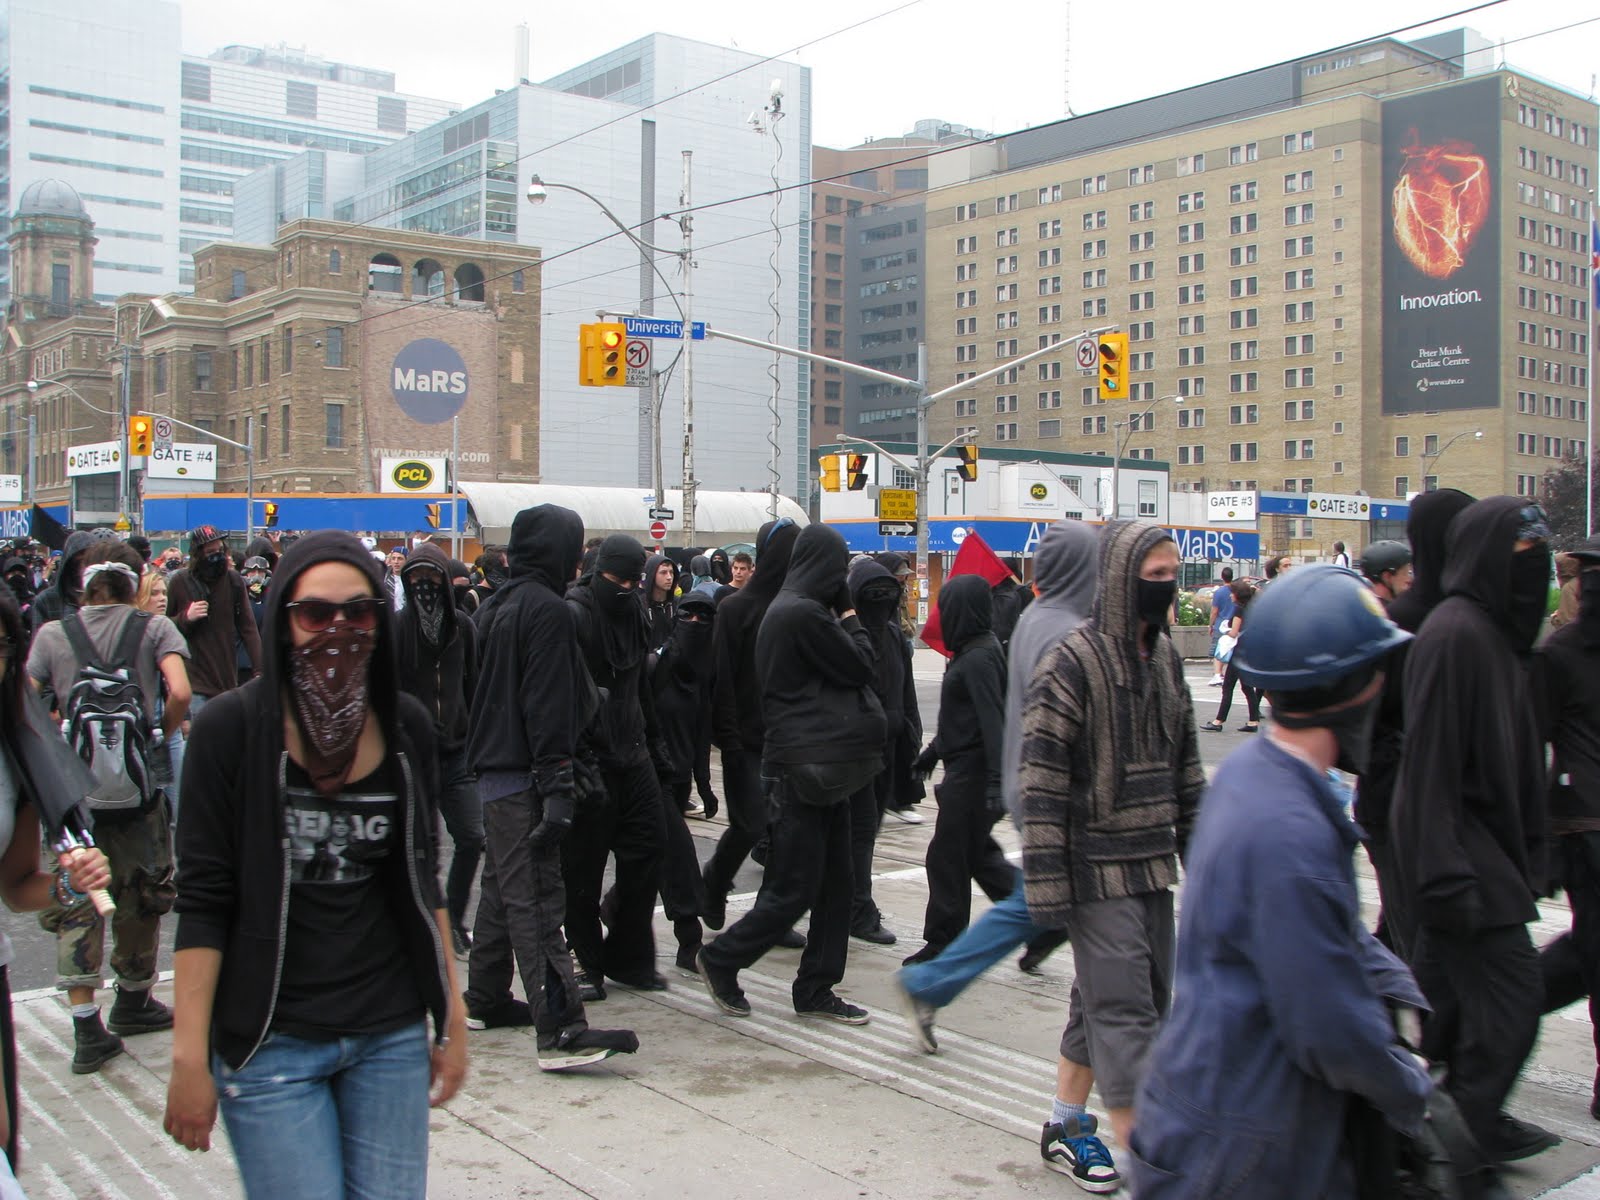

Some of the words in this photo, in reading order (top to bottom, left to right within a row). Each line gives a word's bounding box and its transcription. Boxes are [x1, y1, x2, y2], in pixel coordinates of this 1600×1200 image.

[1400, 288, 1481, 310] Innovation.
[627, 319, 683, 337] University
[1419, 348, 1438, 358] Peter
[1439, 345, 1462, 356] Munk
[1411, 359, 1441, 369] Cardiac
[1442, 357, 1470, 367] Centre
[394, 367, 467, 394] MaRS
[77, 450, 99, 468] GATE
[101, 449, 111, 466] #4
[153, 449, 192, 461] GATE
[196, 451, 213, 462] #4
[398, 468, 427, 481] PCL
[5, 479, 19, 488] #5
[1032, 487, 1046, 495] PCL
[1211, 497, 1238, 506] GATE
[1241, 496, 1253, 506] #3
[1320, 499, 1345, 513] GATE
[1347, 501, 1358, 514] #3
[3, 509, 30, 537] MaRS
[1171, 529, 1234, 559] MaRS
